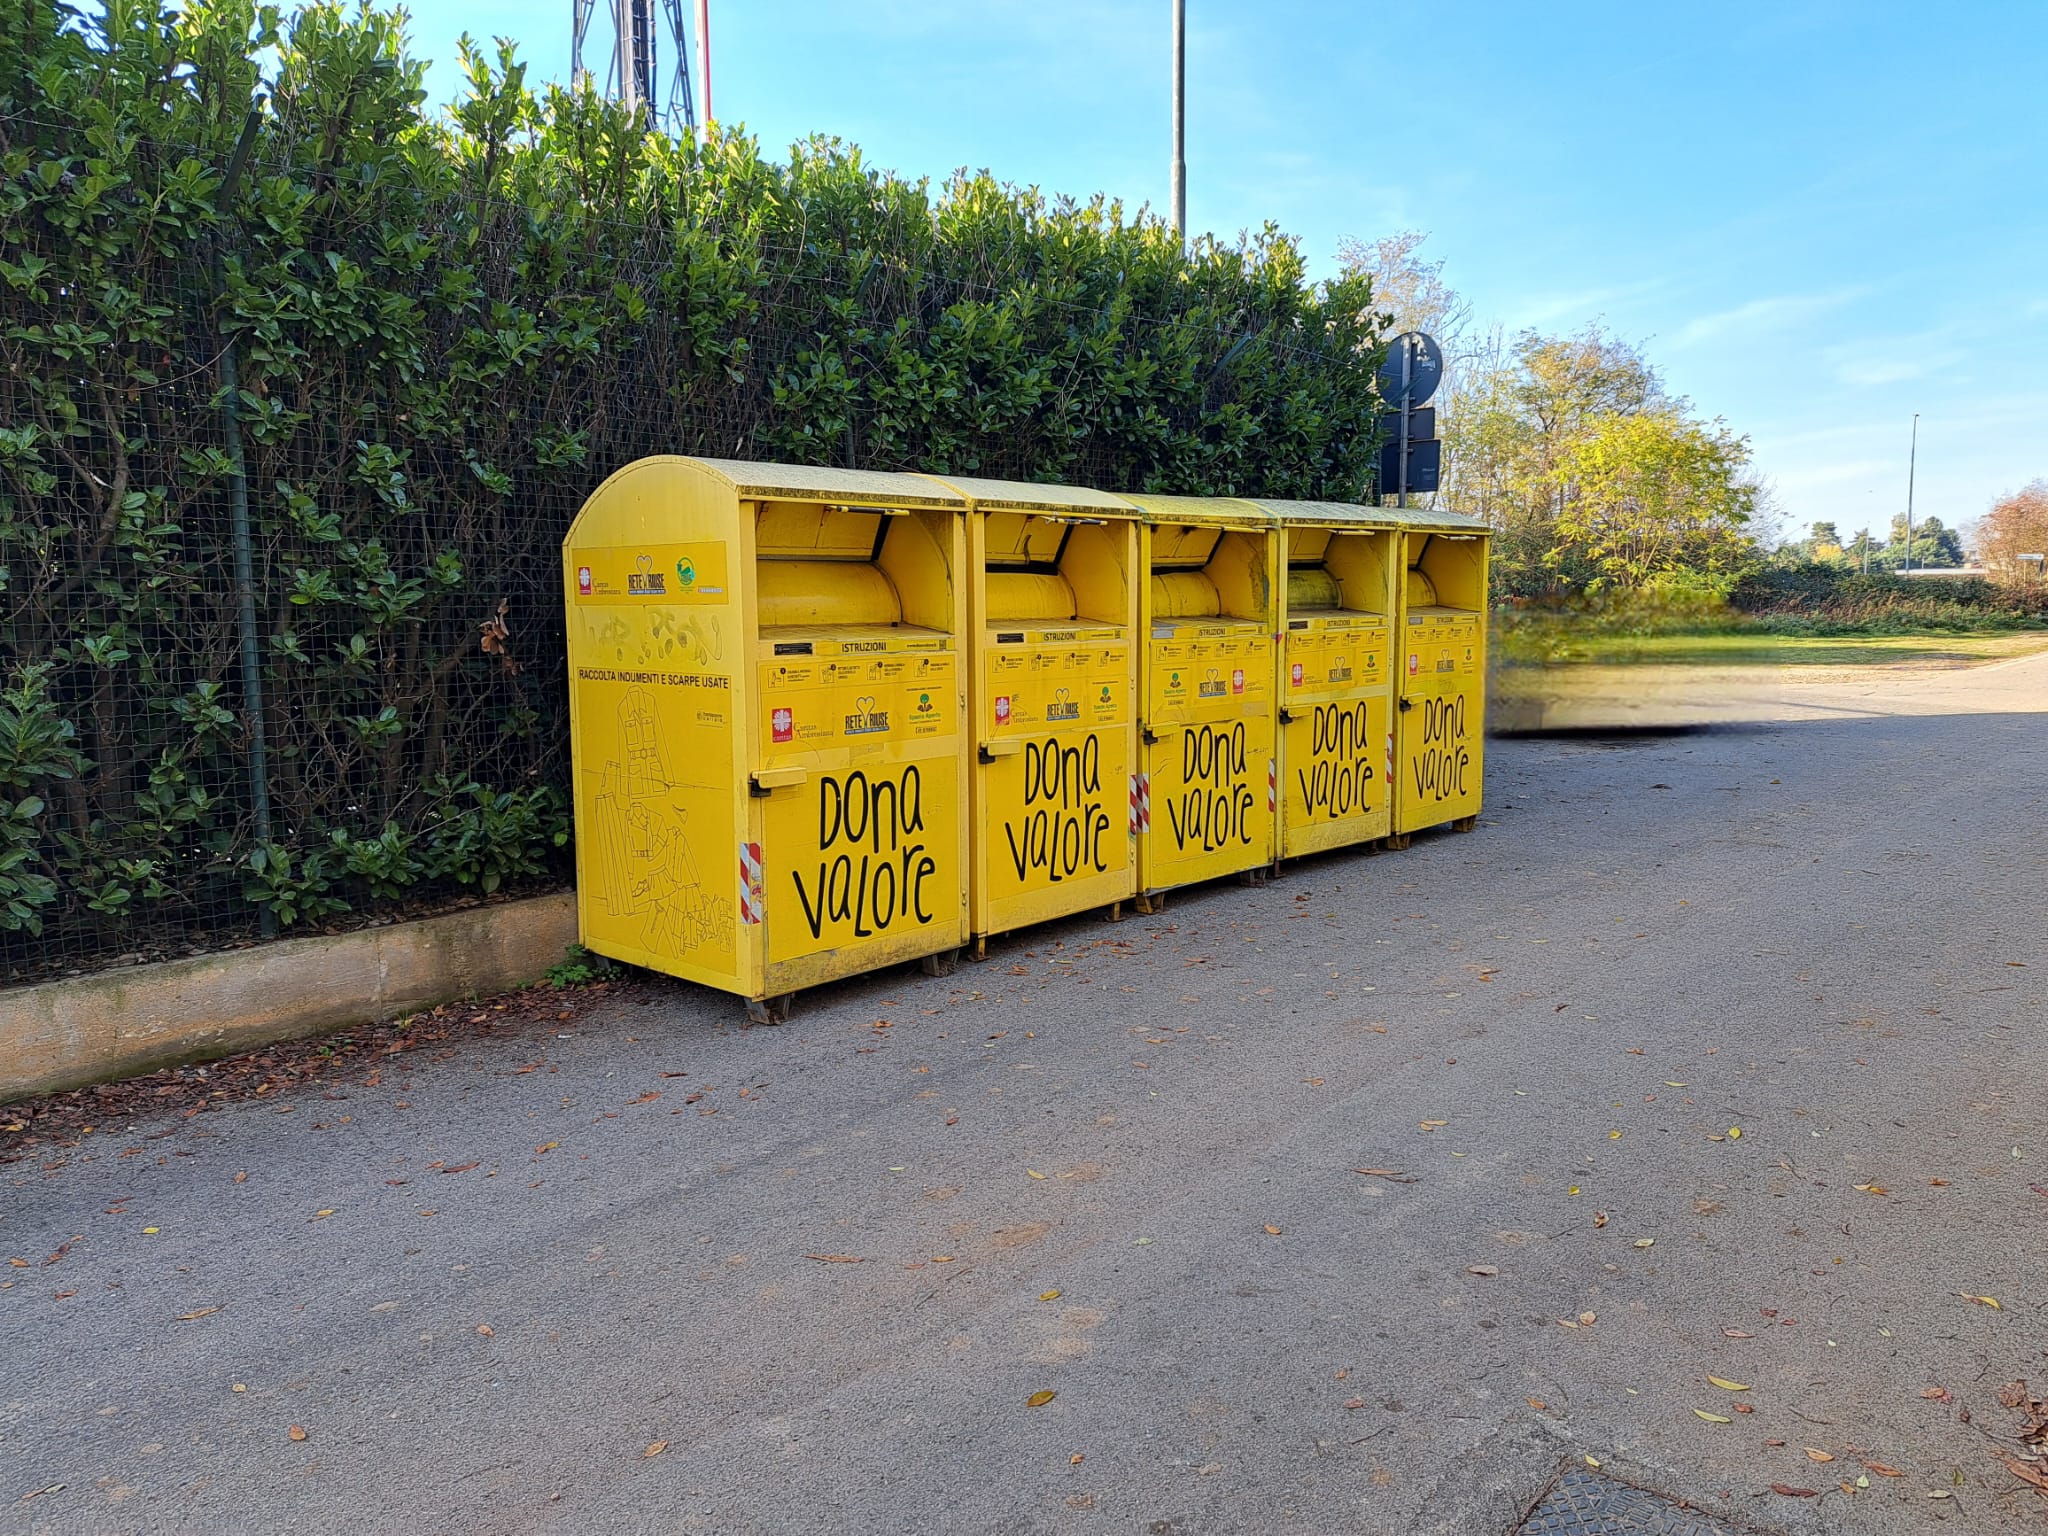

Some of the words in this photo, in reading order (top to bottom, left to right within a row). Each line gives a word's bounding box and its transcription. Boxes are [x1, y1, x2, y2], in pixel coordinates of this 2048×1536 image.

[1043, 632, 1076, 641] ISTRUZIONI
[842, 642, 887, 653] ISTRUZIONI
[579, 669, 616, 681] RACCOLTA
[617, 671, 660, 685] INDUMENTI
[661, 674, 666, 684] E
[668, 675, 700, 687] SCARPE
[702, 676, 729, 689] USATE
[845, 714, 862, 729] RETE
[869, 711, 889, 727] RIUSE
